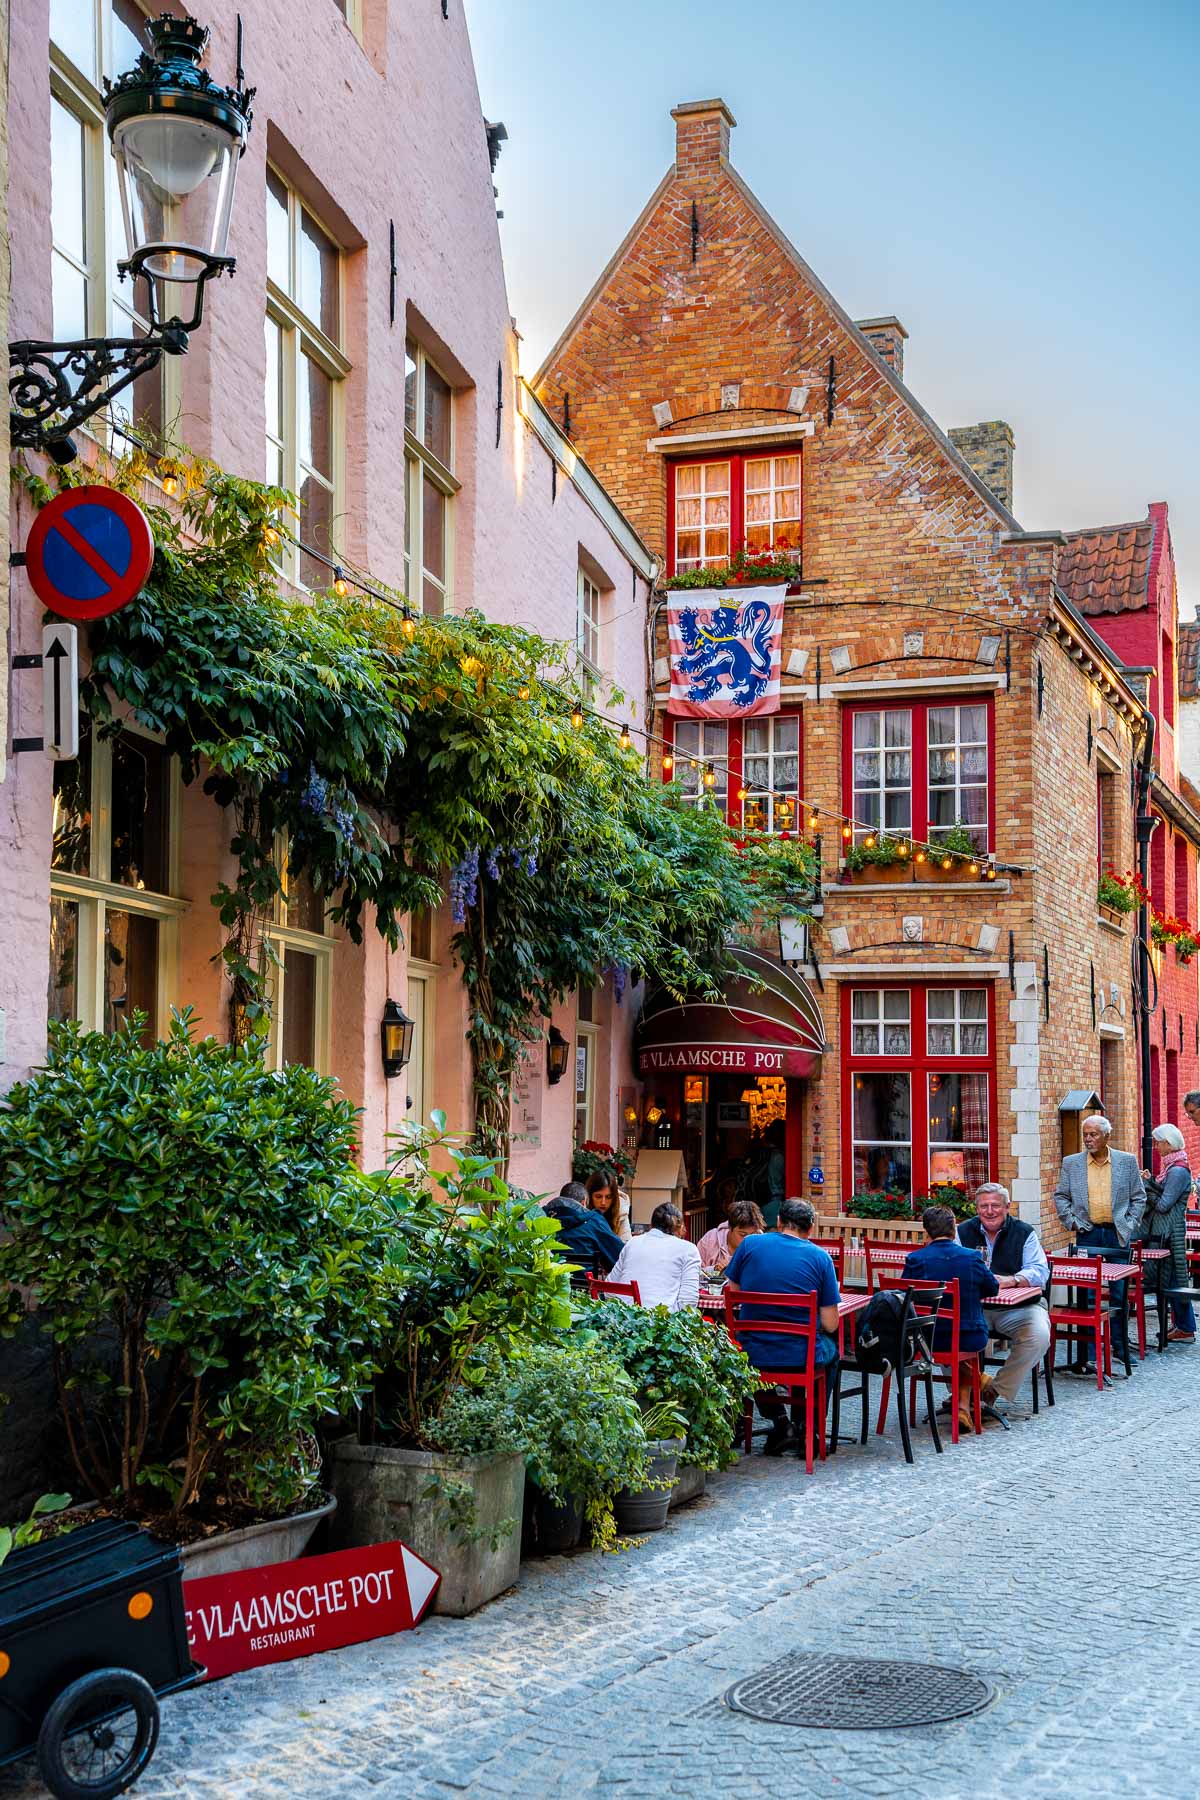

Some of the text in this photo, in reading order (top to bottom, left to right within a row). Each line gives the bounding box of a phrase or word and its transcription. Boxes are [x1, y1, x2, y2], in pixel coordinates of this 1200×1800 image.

[650, 1050, 746, 1067] VLAAMSCHE
[754, 1052, 784, 1069] POT
[197, 1580, 347, 1641] VLAAMSCHE
[348, 1569, 395, 1608] POT
[250, 1624, 316, 1651] RESTAURANT
